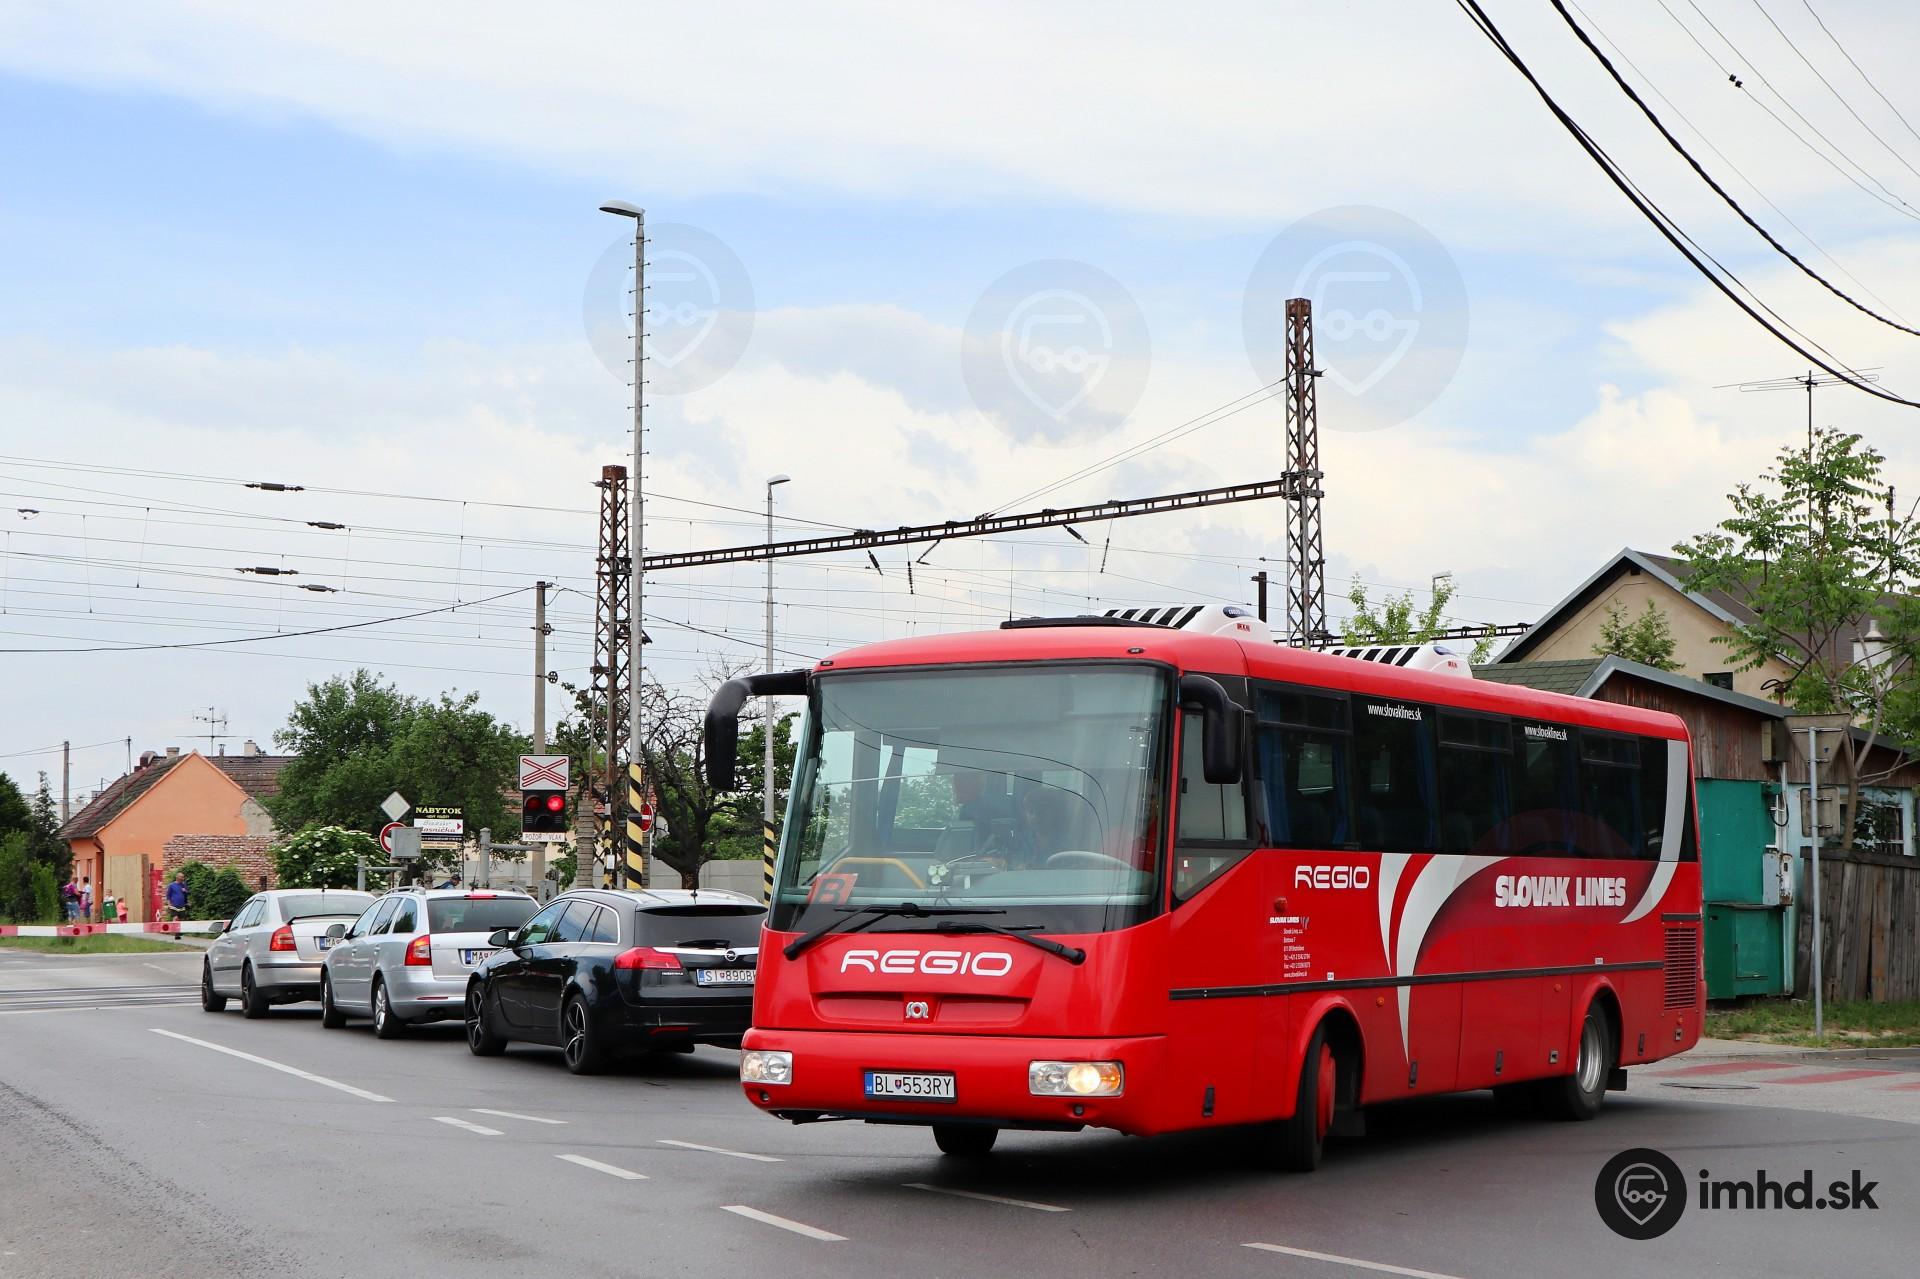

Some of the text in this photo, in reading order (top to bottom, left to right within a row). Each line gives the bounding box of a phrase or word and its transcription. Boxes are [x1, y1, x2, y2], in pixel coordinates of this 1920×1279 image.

[1367, 703, 1422, 721] www.slovaklines.sk
[1524, 725, 1568, 741] www.slovaklines.sk
[1294, 865, 1370, 889] REGIO
[1495, 875, 1626, 907] SLOVAK LINES
[840, 949, 1013, 977] REGIO
